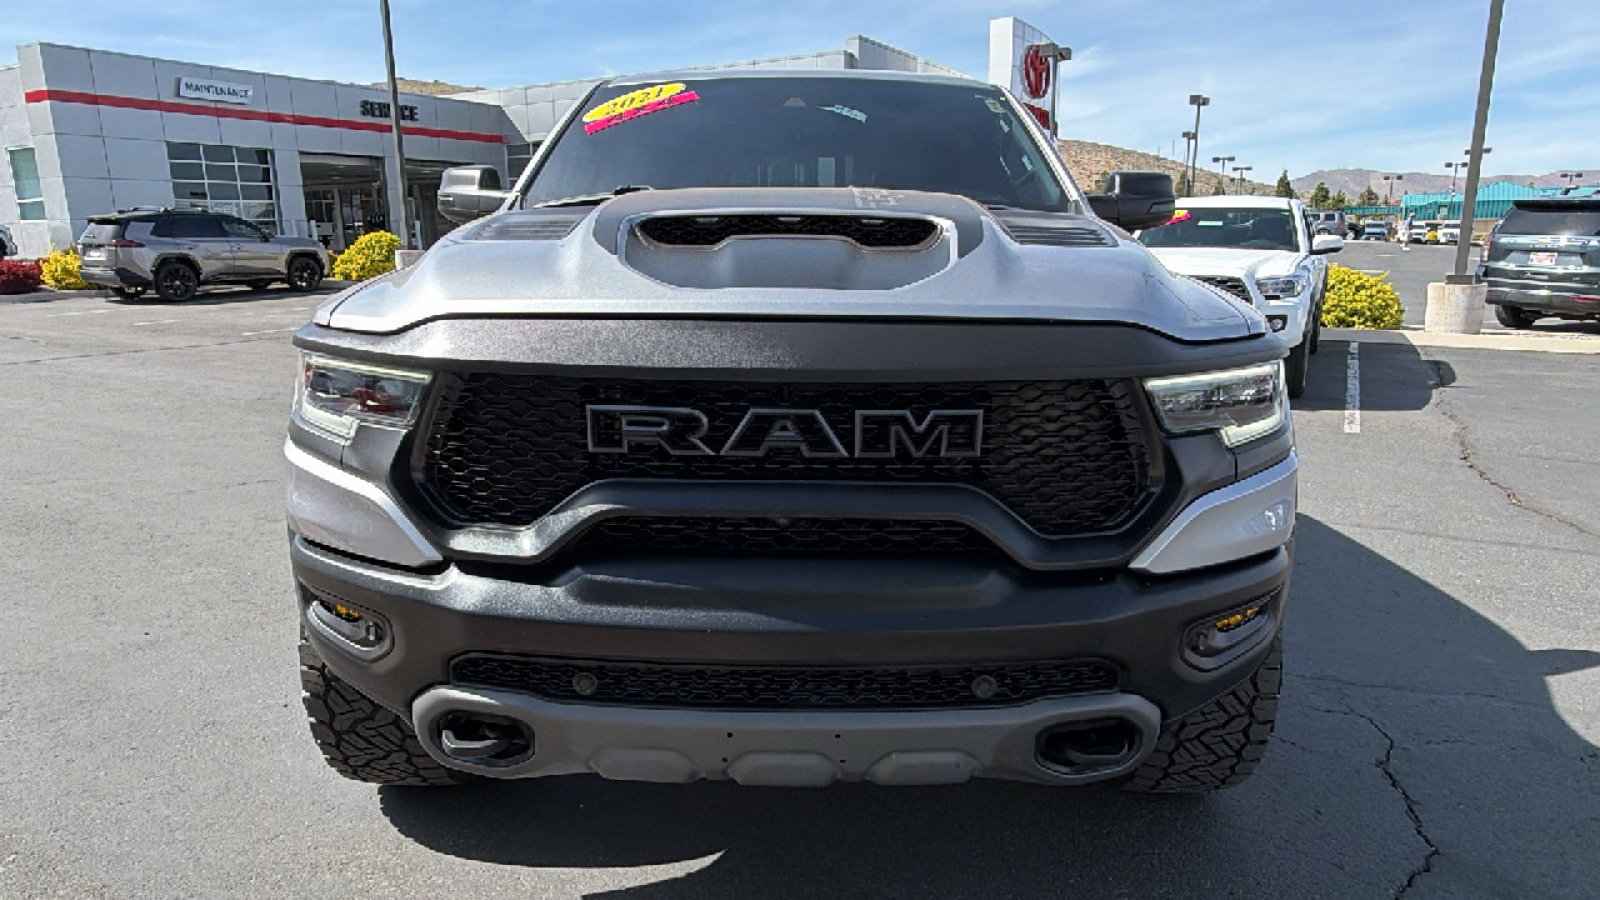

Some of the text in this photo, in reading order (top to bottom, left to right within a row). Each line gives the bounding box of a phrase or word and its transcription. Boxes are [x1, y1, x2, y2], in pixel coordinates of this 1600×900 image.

[184, 82, 249, 98] MAINTENANCE
[604, 86, 664, 115] 2021
[586, 404, 984, 458] RAM
